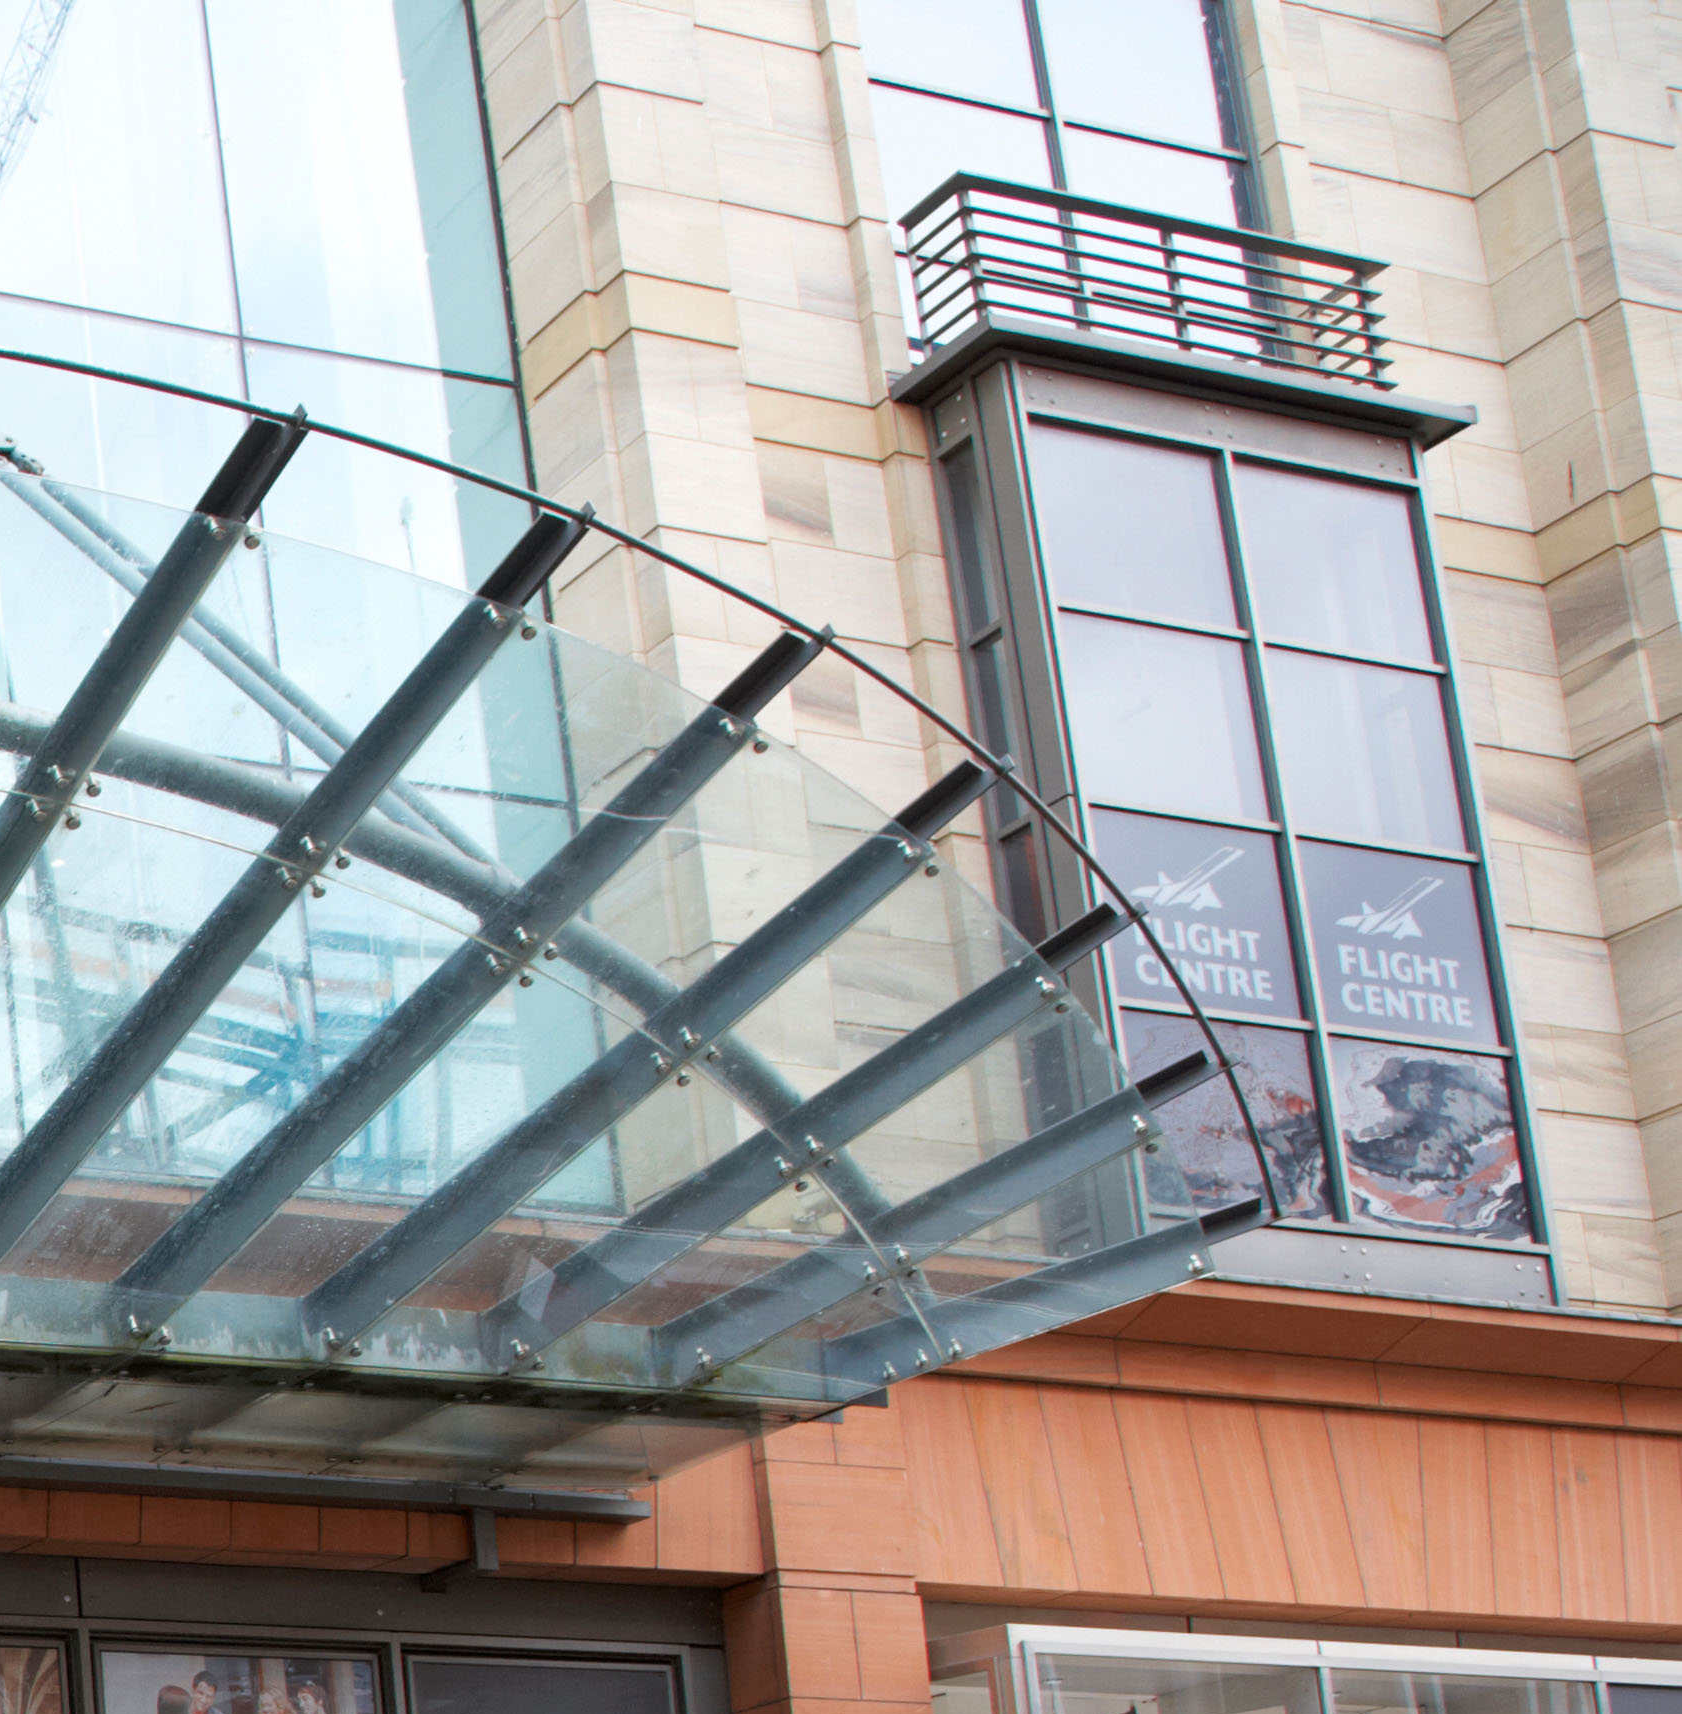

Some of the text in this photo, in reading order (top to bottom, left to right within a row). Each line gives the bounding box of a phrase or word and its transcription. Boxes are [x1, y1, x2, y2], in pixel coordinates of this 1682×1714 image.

[1135, 915, 1262, 963] FLIGHT
[1135, 952, 1274, 1003] CENTRE
[1339, 943, 1460, 991] FLIGHT
[1340, 980, 1473, 1029] CENTRE
